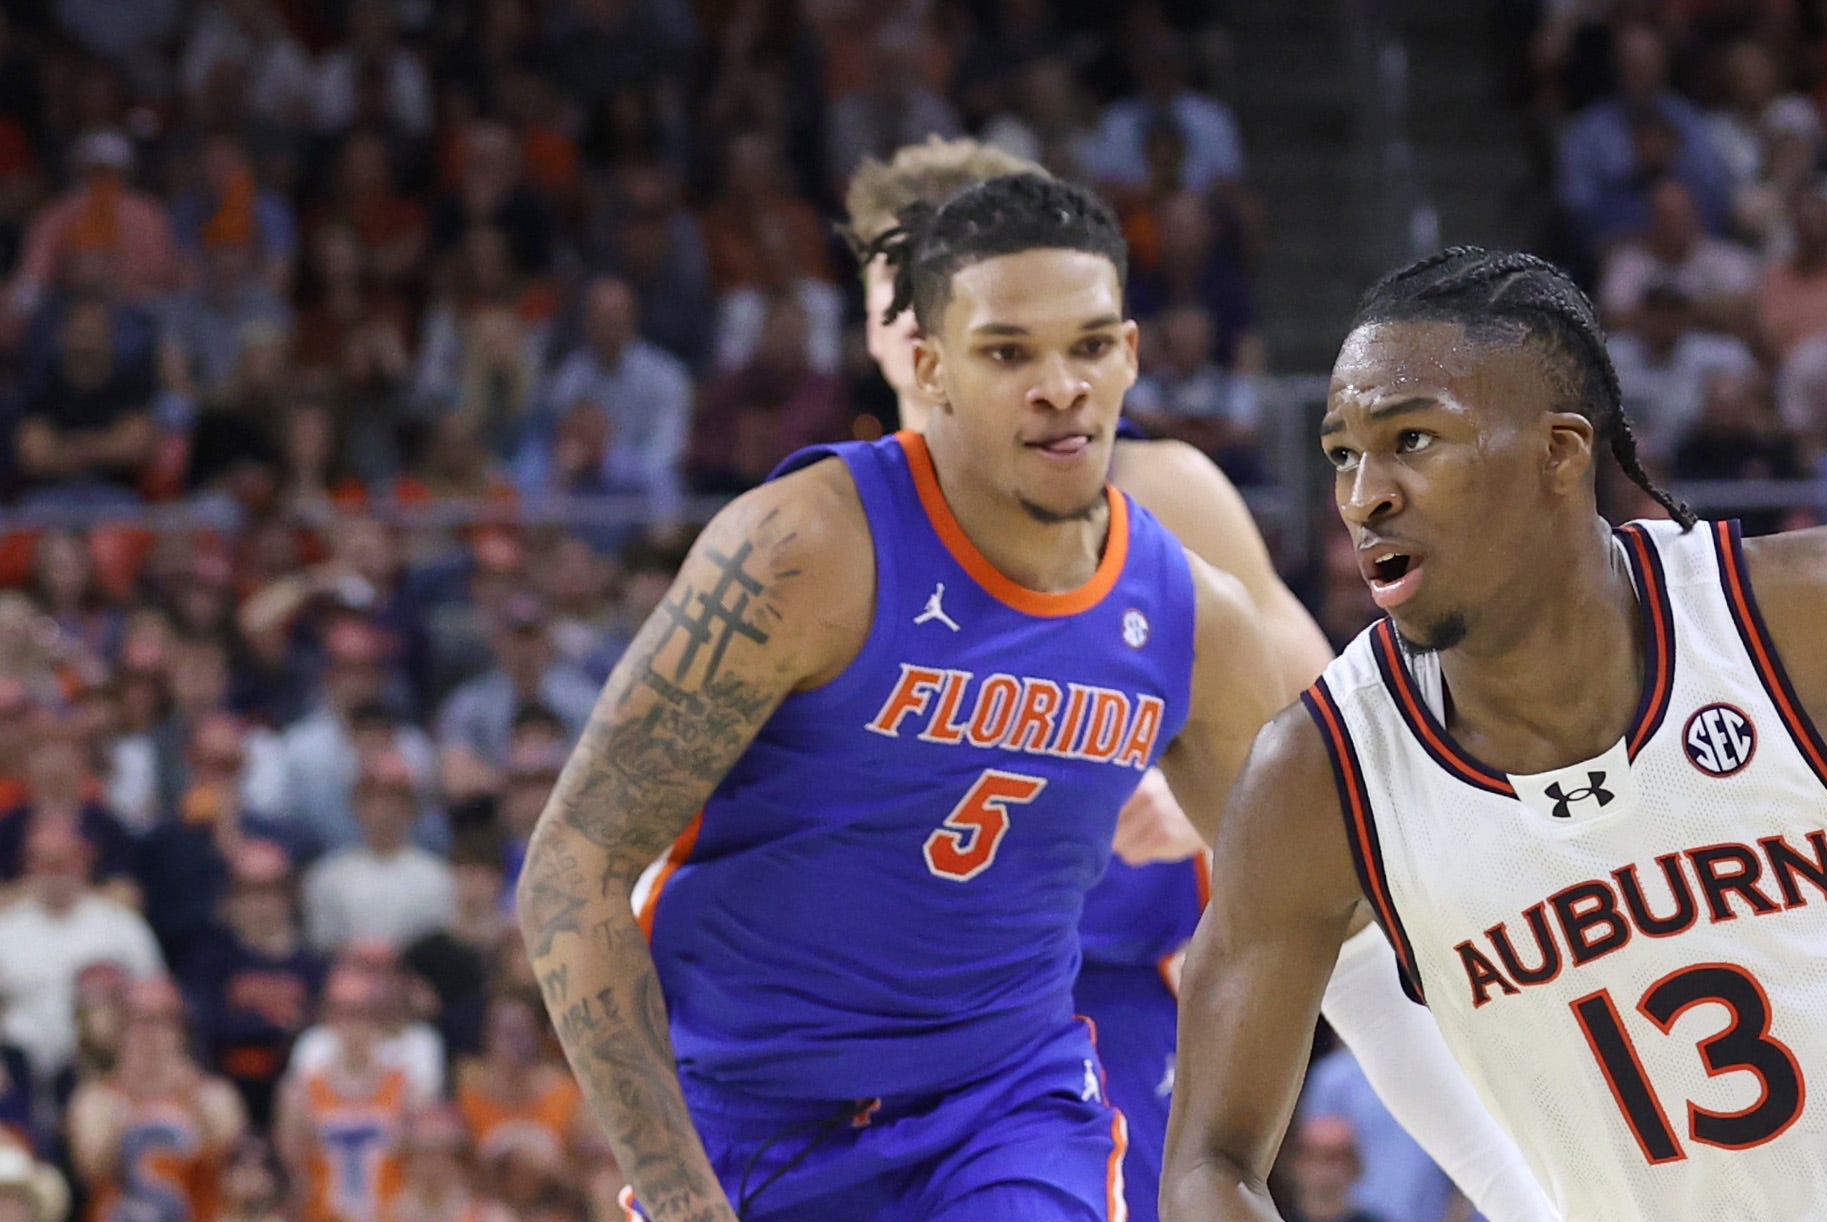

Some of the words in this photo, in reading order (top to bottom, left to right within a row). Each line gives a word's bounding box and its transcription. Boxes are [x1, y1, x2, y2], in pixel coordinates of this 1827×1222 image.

[866, 663, 1165, 770] FLORIDA
[1687, 707, 1752, 773] SEC
[922, 768, 1047, 882] 5
[1568, 961, 1807, 1167] 13
